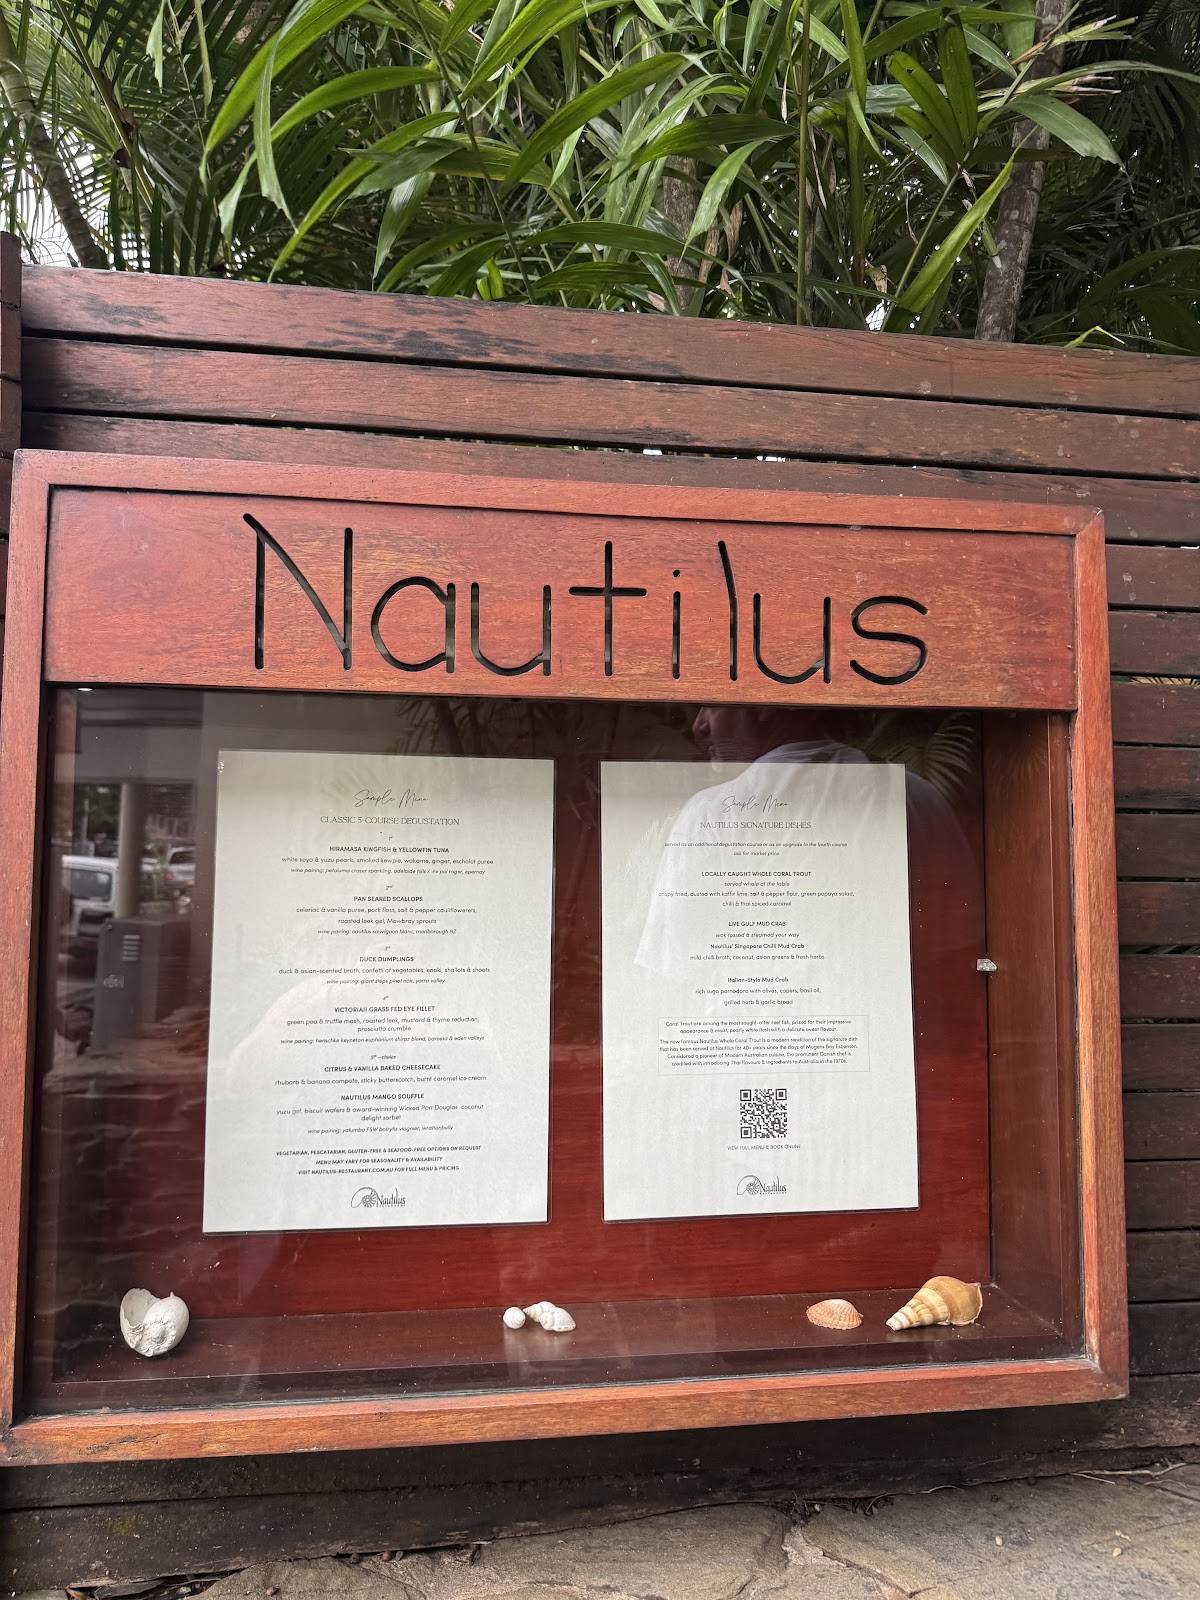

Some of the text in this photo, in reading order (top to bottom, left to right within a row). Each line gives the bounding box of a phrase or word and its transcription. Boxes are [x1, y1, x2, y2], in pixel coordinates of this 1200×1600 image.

[243, 513, 928, 685] Nautilus
[353, 789, 429, 808] Sample Menu
[722, 794, 789, 813] Sample Menu
[320, 815, 460, 825] CLASSIC 5-COURSE DEGUSTATION
[700, 821, 739, 829] NAUTILUS
[740, 821, 784, 829] SIGNATURE
[724, 999, 741, 1007] grilled
[759, 1176, 787, 1192] Nautilus
[376, 1187, 406, 1206] Nautilus
